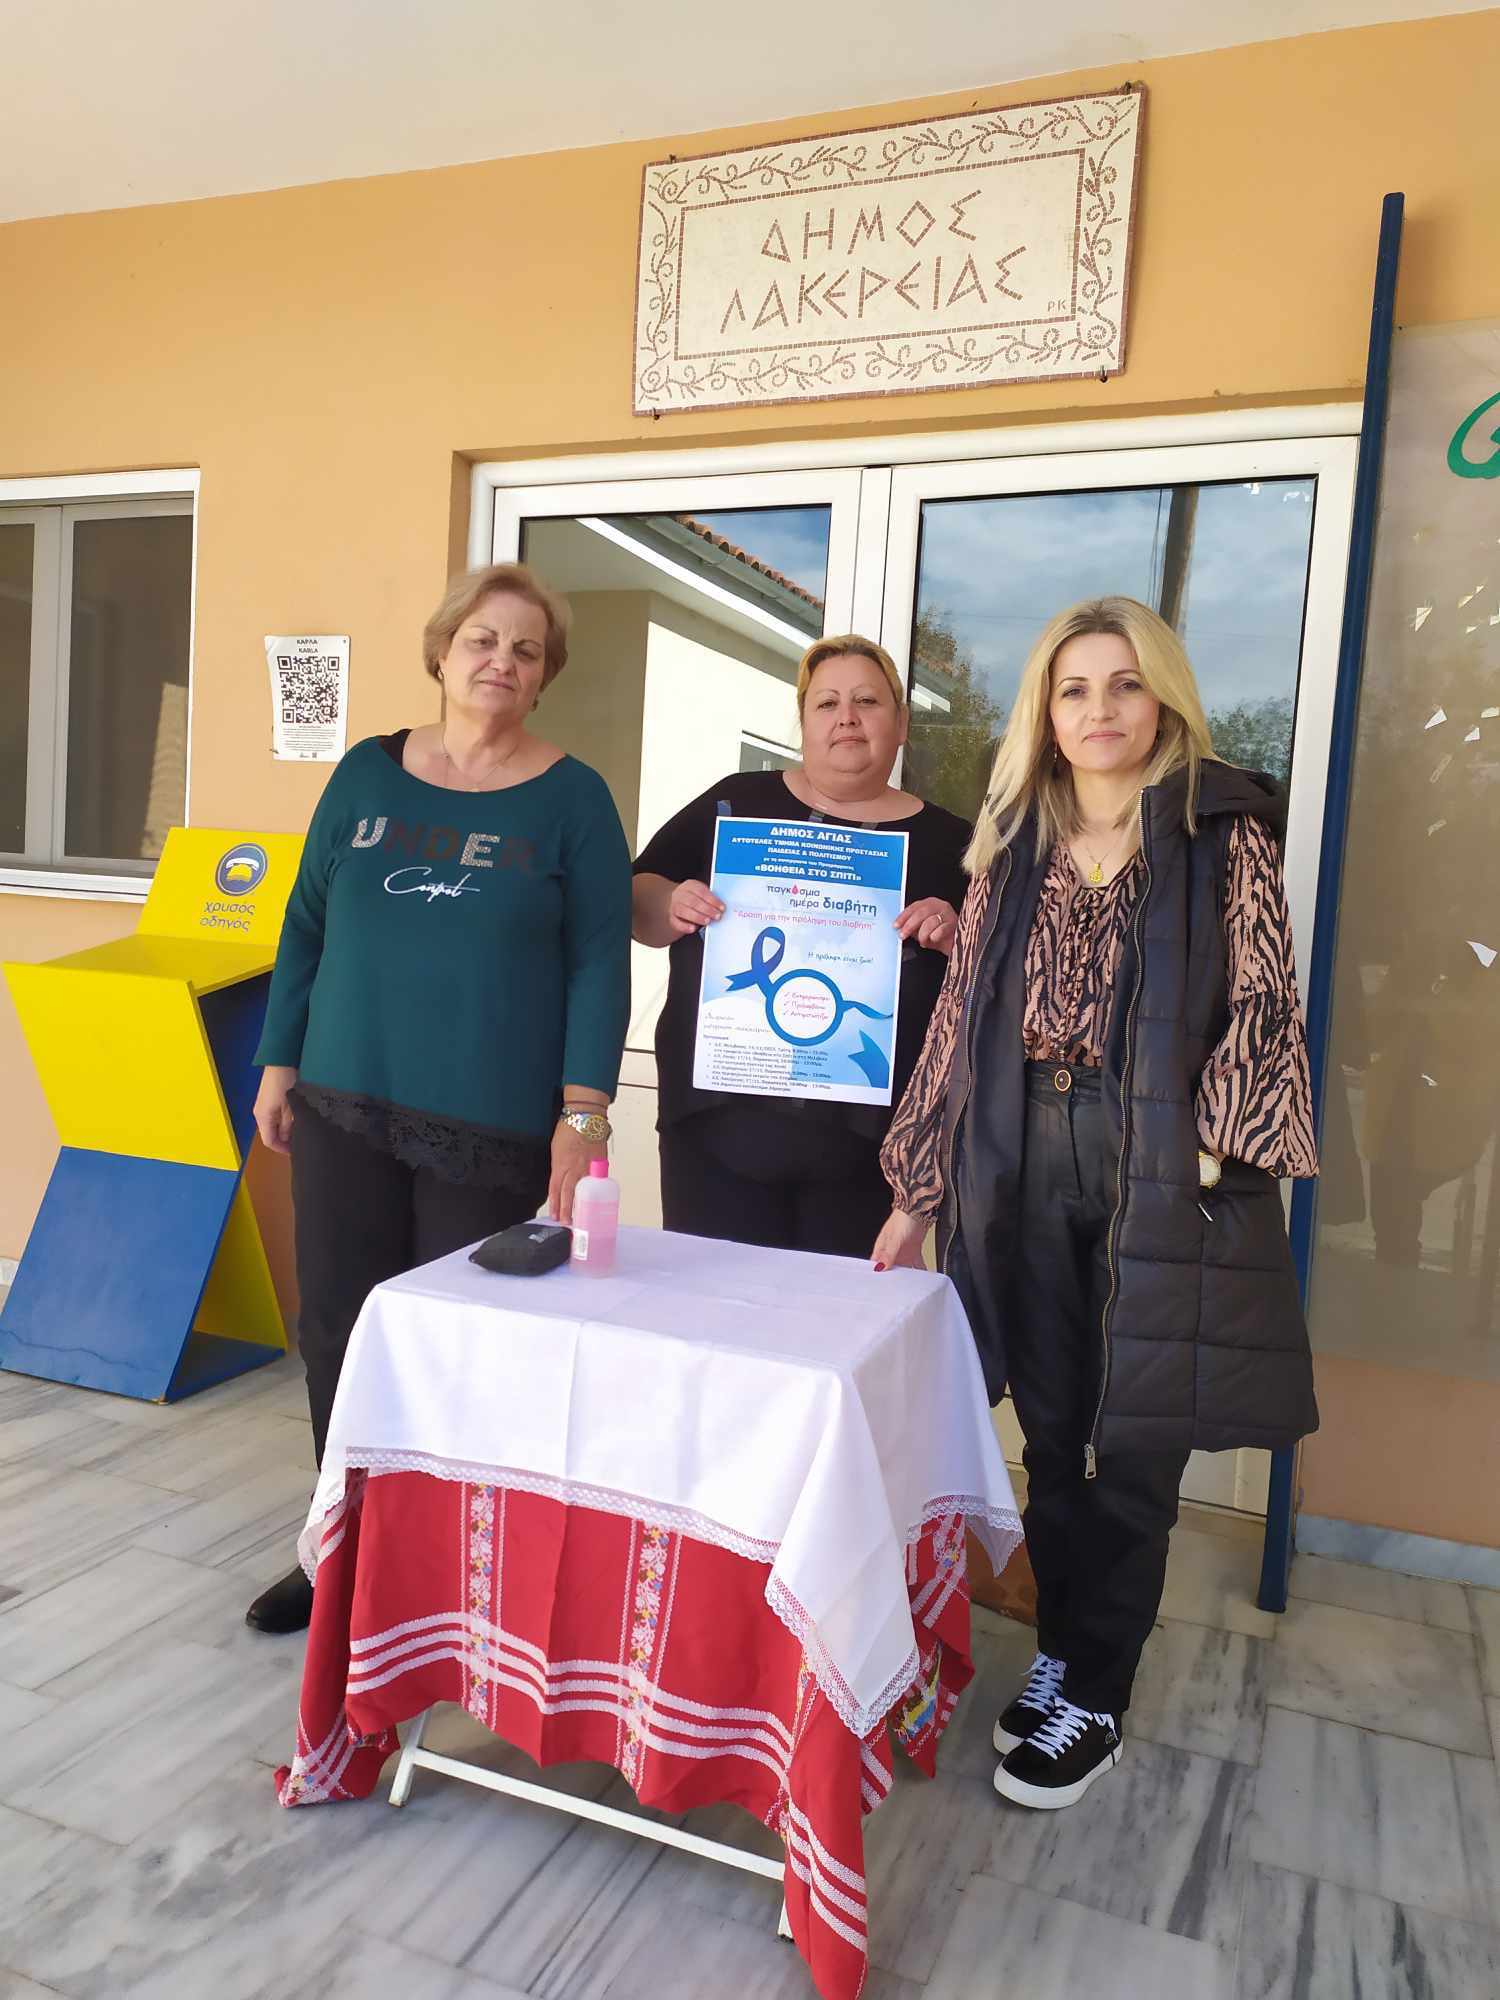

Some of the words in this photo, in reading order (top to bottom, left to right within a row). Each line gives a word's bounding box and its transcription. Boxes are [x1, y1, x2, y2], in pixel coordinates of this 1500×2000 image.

[760, 189, 982, 264] ΔΗΜΟΣ
[719, 246, 1027, 334] ΛΑΚΕΡΕΙΑΣ
[351, 816, 537, 871] UNDER
[770, 826, 815, 839] ΔΗΜΟΣ
[816, 831, 853, 844] ΑΓΙΑΣ
[808, 868, 828, 877] ΣΤΟ
[830, 870, 862, 881] ΣΠΙΤΙ»
[204, 901, 256, 915] χρυσός
[790, 897, 819, 908] ημέρα
[823, 896, 877, 917] διαβήτη
[199, 915, 251, 931] οδηγός
